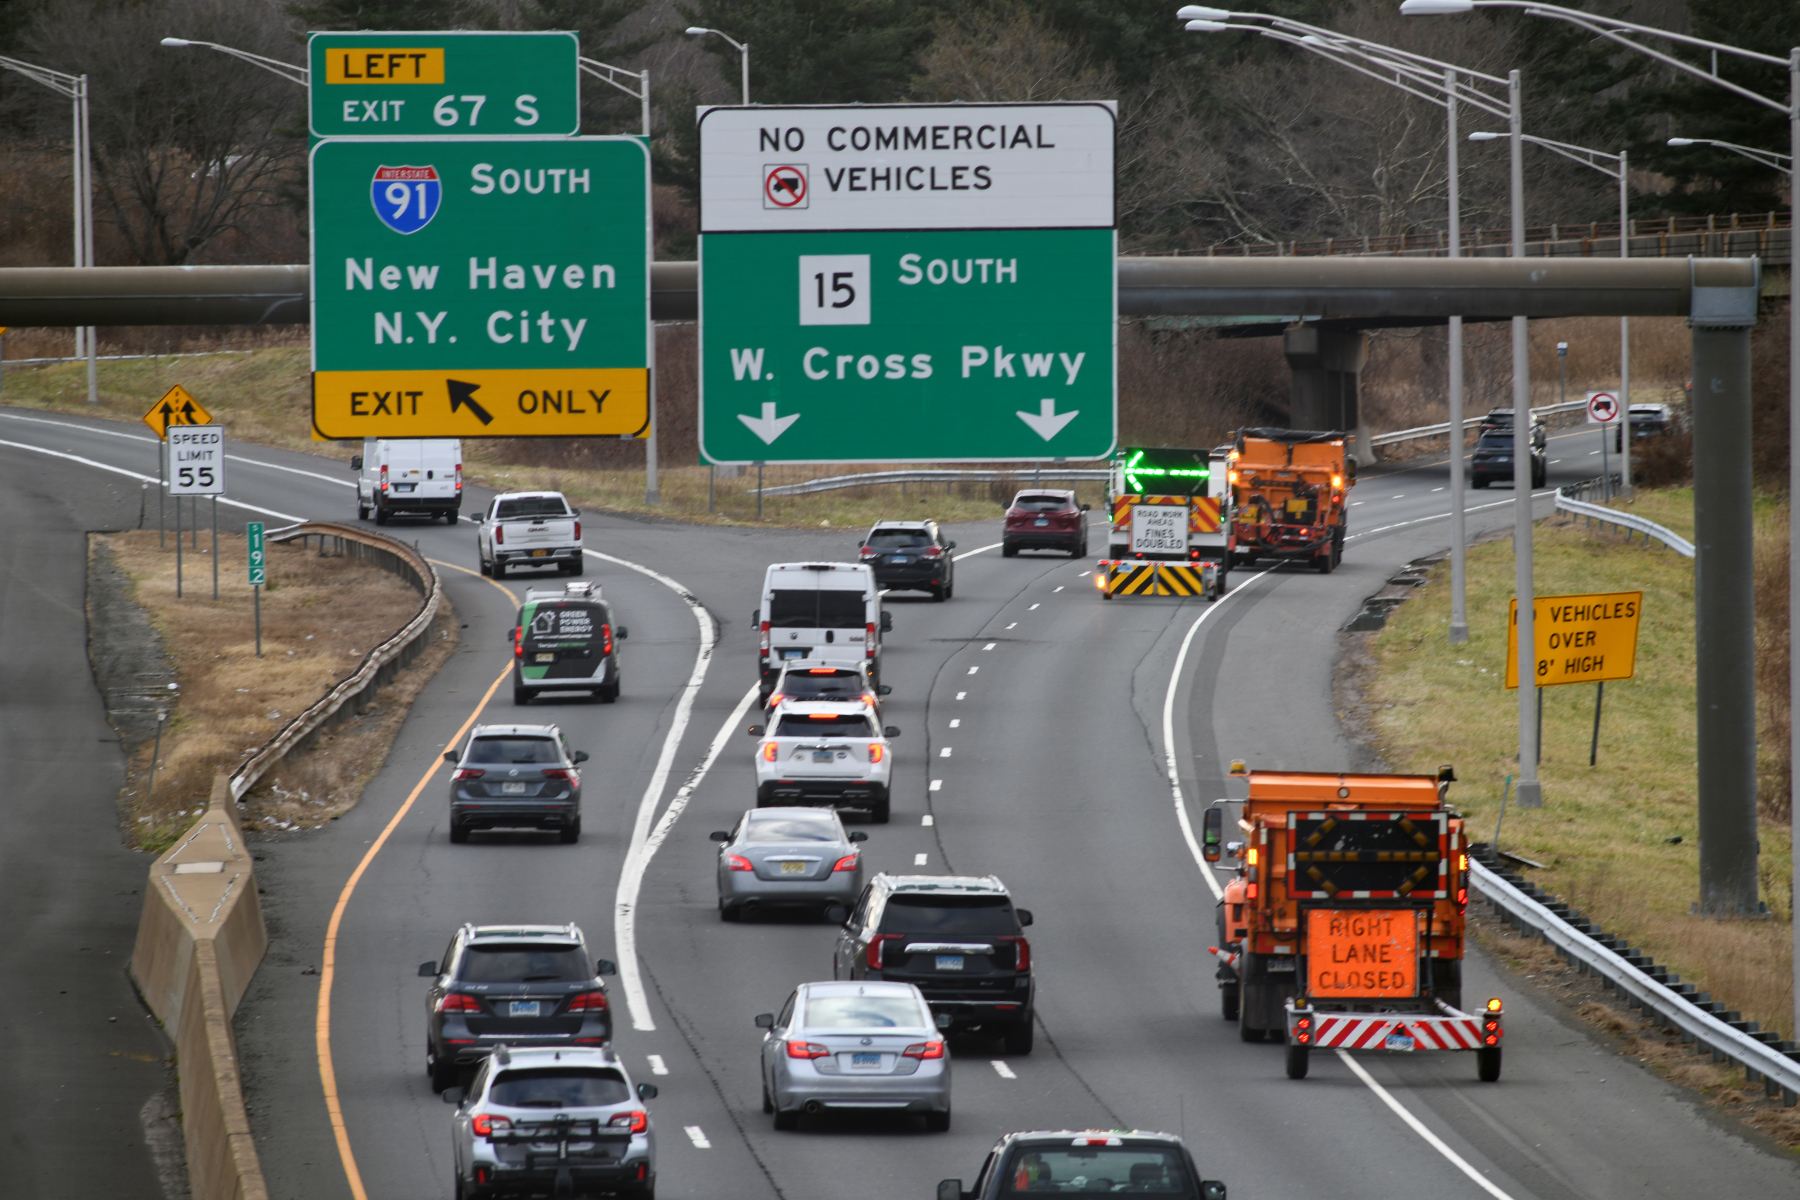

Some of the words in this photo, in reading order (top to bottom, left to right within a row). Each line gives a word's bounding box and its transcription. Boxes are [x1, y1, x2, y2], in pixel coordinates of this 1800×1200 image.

[343, 53, 427, 79] LEFT
[342, 100, 406, 122] EXIT
[433, 94, 487, 127] 67
[513, 94, 540, 127] S
[759, 127, 805, 152] NO
[826, 123, 1056, 152] COMMERCIAL
[381, 169, 430, 180] INTERSTATE
[824, 165, 993, 192] VEHICLES
[385, 182, 427, 219] 91
[345, 257, 440, 291] New
[469, 256, 616, 290] Haven
[813, 271, 857, 309] 15
[374, 311, 458, 345] N.Y.
[486, 309, 588, 352] City
[730, 348, 775, 382] W.
[802, 346, 934, 381] Cross
[962, 344, 1086, 386] Pkwy
[350, 391, 424, 416] EXIT
[518, 389, 612, 415] ONLY
[172, 433, 220, 445] SPEED
[177, 450, 215, 462] LIMIT
[178, 467, 215, 488] 55
[1137, 510, 1159, 518] ROAD
[1161, 510, 1184, 519] WORK
[1147, 518, 1174, 526] AHEAD
[1136, 538, 1184, 549] DOUBLED
[1145, 528, 1175, 539] FINES
[559, 610, 588, 618] GREEN
[559, 618, 591, 626] POWER
[1550, 601, 1636, 623] VEHICLES
[559, 625, 593, 633] ENERGY
[1549, 630, 1597, 650] OVER
[1564, 655, 1605, 675] HIGH
[1329, 917, 1395, 938] RIGHT
[1332, 944, 1392, 964] LANE
[1318, 971, 1406, 991] CLOSED
